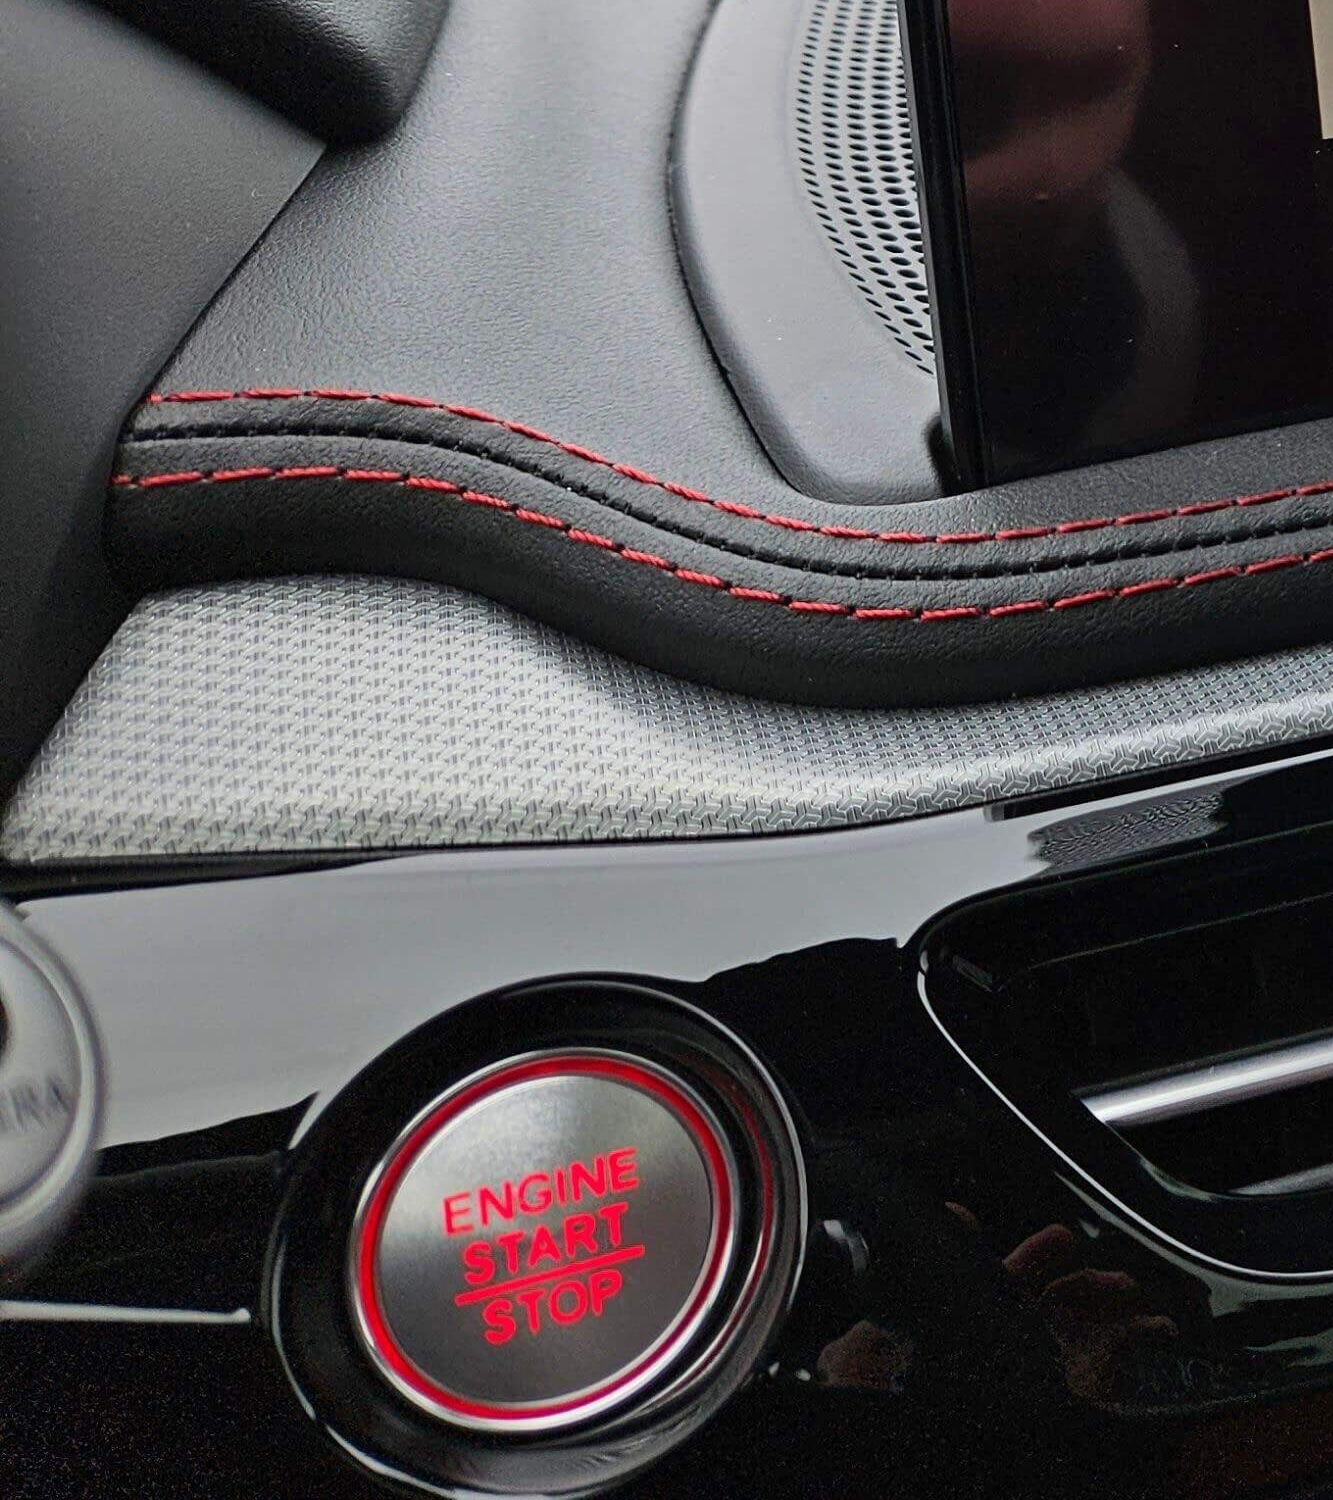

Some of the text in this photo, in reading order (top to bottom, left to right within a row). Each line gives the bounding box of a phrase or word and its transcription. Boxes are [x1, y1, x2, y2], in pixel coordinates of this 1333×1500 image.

[442, 1145, 641, 1236] ENGINE
[462, 1201, 630, 1286] START
[482, 1268, 624, 1346] STOP
